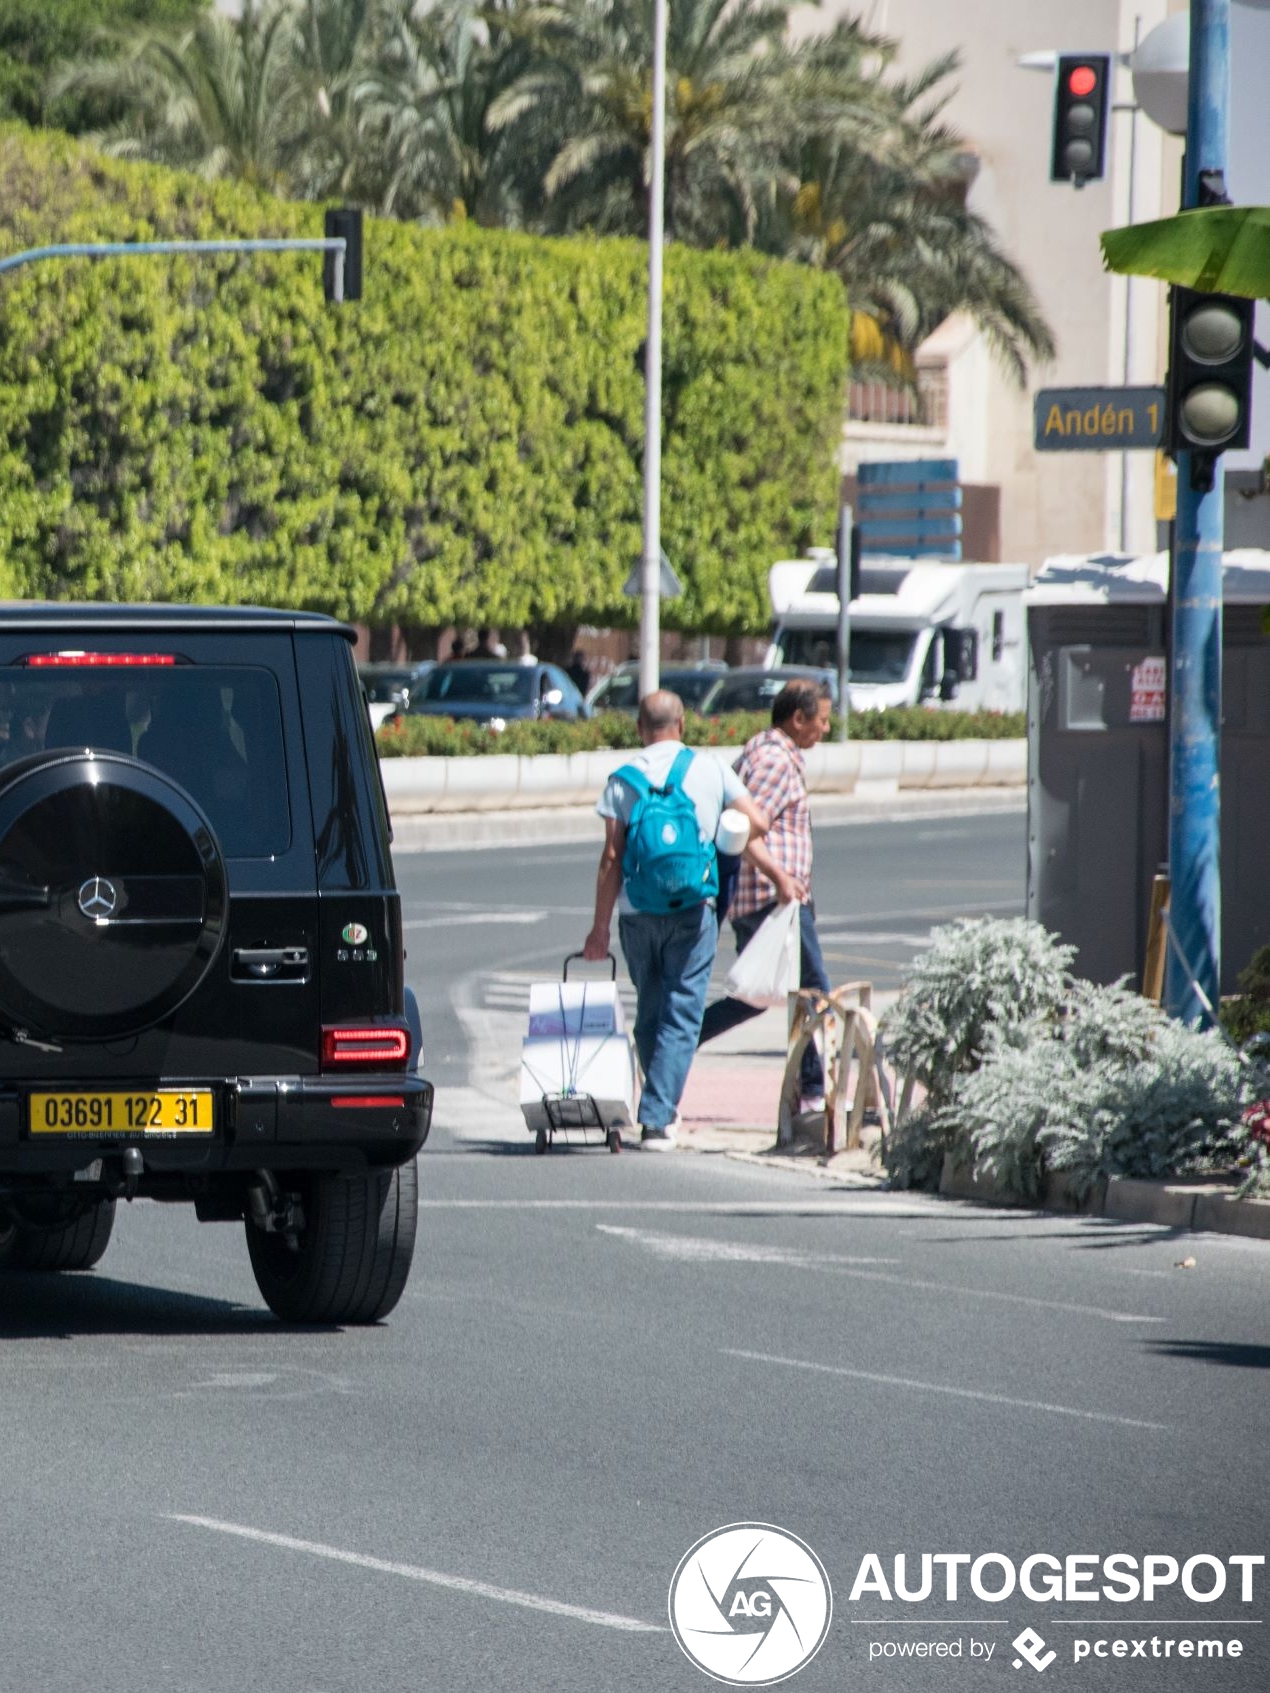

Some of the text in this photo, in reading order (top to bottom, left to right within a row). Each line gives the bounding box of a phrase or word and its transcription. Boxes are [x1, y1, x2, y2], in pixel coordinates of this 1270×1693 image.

[1044, 402, 1158, 436] Andén 1
[45, 1096, 198, 1127] 03691 122 31
